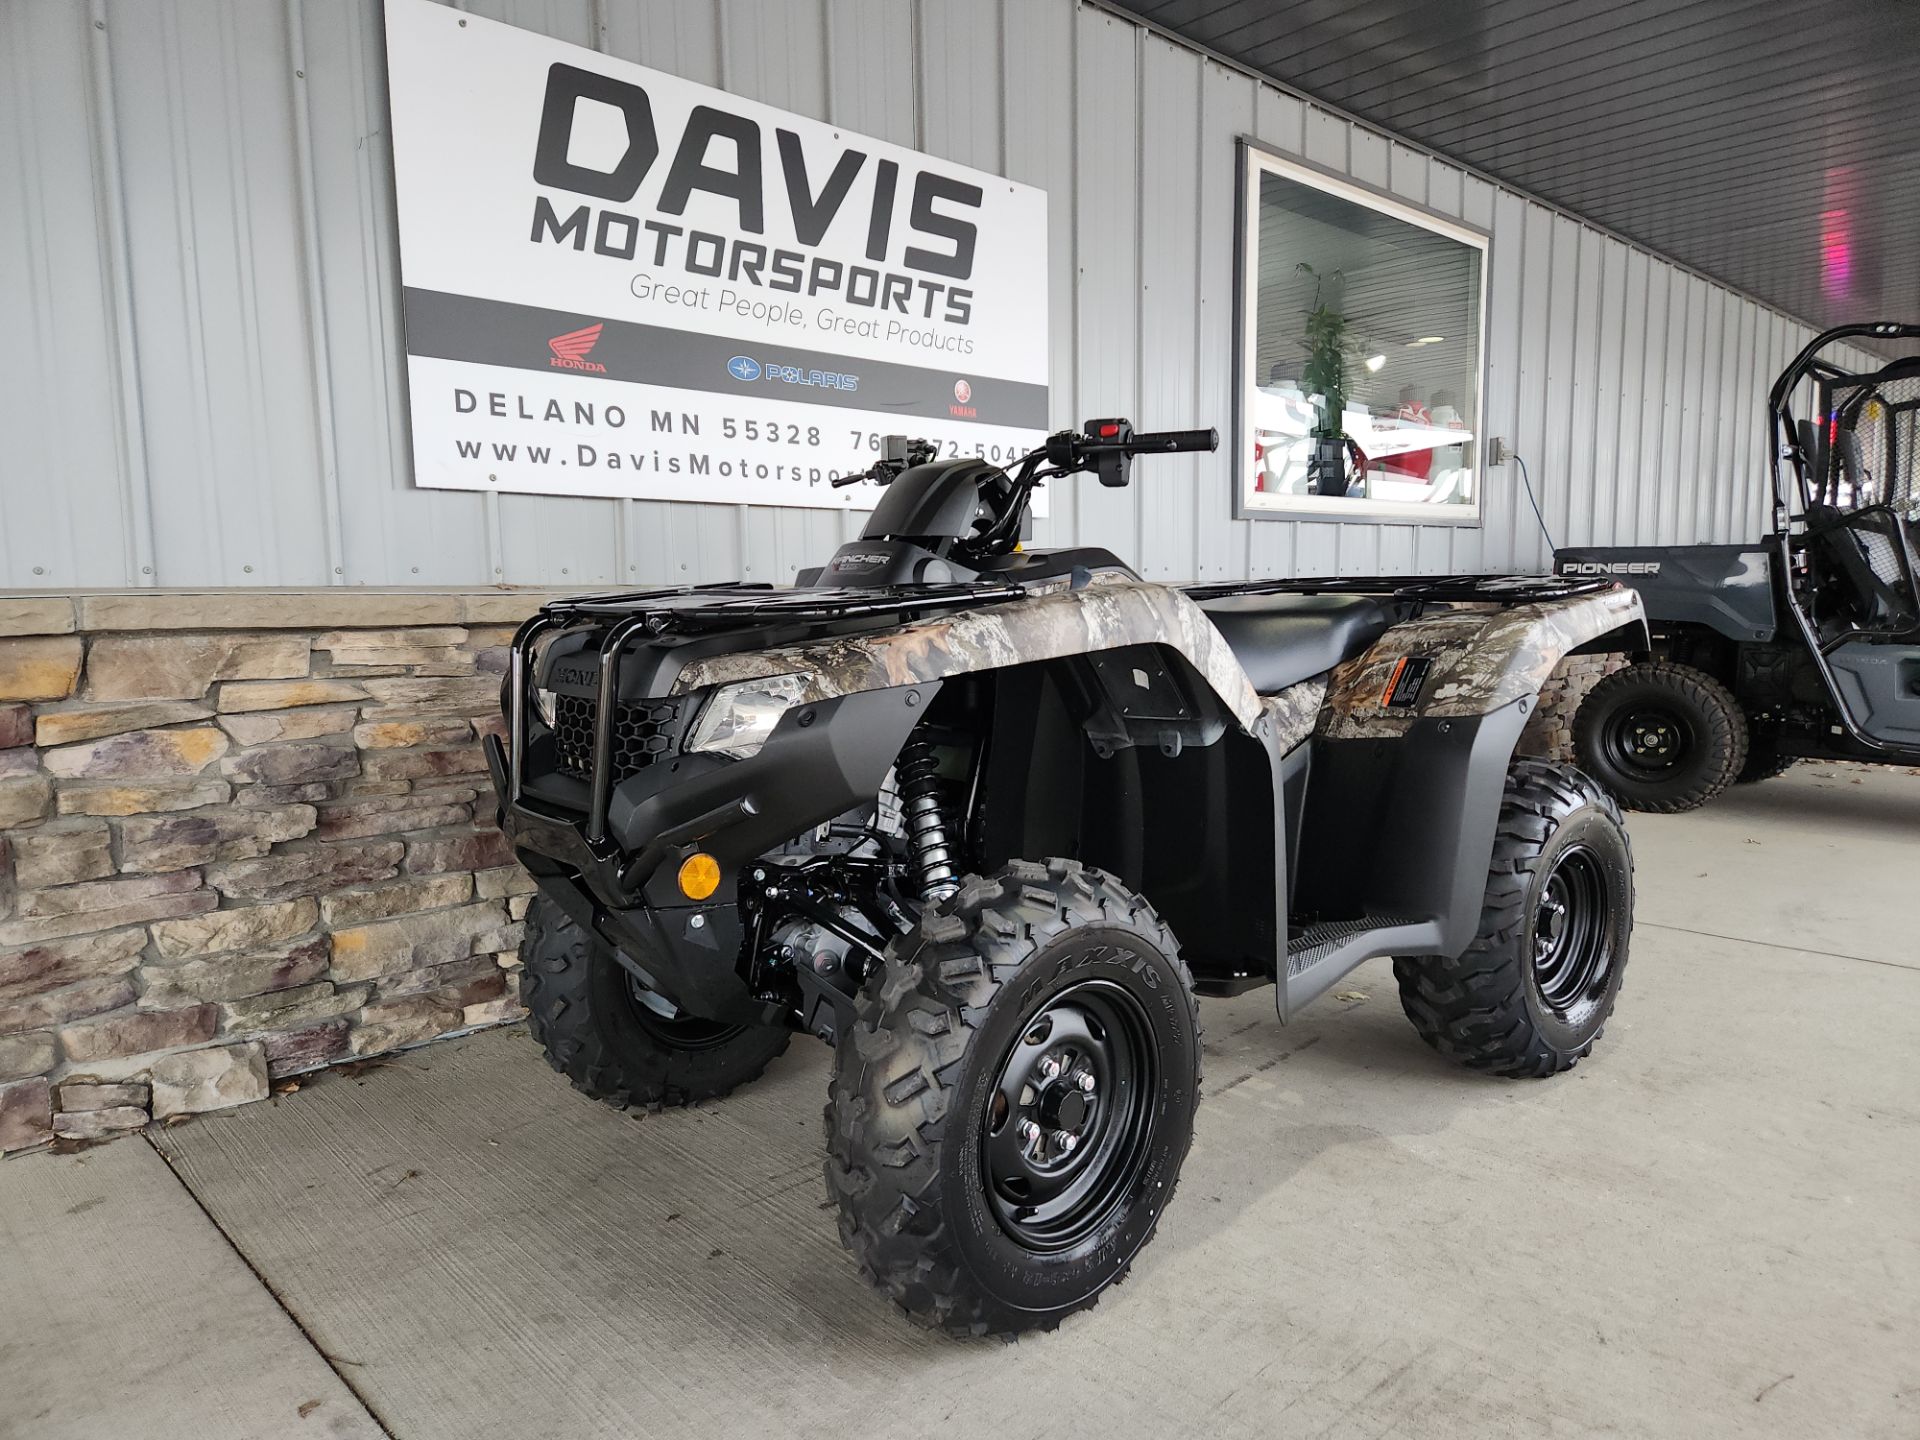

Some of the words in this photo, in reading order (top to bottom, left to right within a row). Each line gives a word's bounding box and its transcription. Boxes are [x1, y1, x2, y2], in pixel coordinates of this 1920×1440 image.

[533, 62, 983, 280] DAVIS
[530, 196, 974, 325] MOTORSPORTS
[630, 273, 709, 310] Great
[719, 289, 807, 329] People,
[817, 308, 880, 340] Great
[886, 320, 975, 355] Products
[549, 357, 608, 373] HONDA
[765, 363, 859, 392] POLARIS
[454, 388, 626, 428] DELANO
[650, 410, 700, 436] MN
[722, 417, 822, 446] 55328
[949, 404, 977, 419] YAMAHA
[1562, 562, 1661, 574] PIONEER
